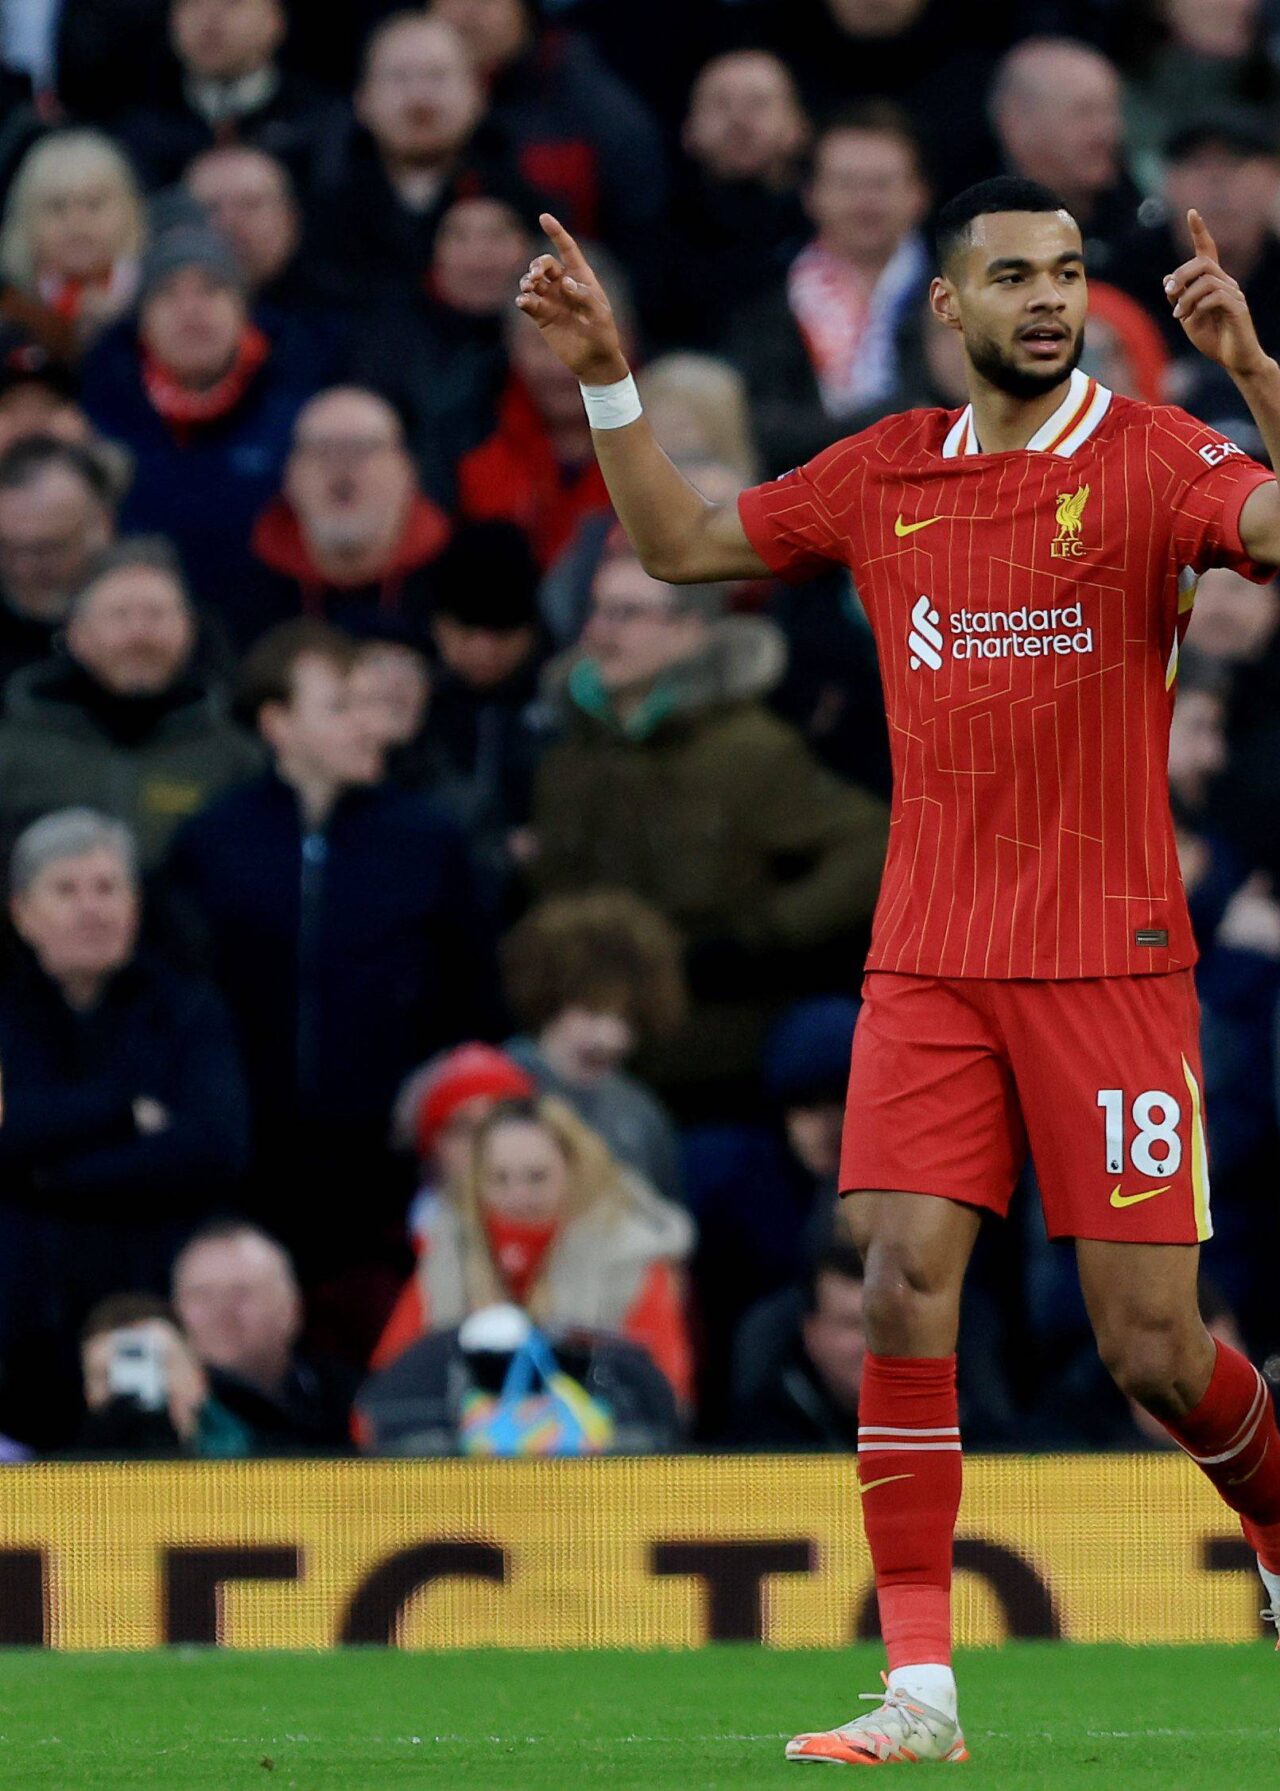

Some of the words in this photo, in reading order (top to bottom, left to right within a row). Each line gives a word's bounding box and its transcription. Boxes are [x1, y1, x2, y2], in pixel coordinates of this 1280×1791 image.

[949, 602, 1082, 634] standard
[952, 627, 1093, 660] chartered
[1097, 1088, 1182, 1178] 18
